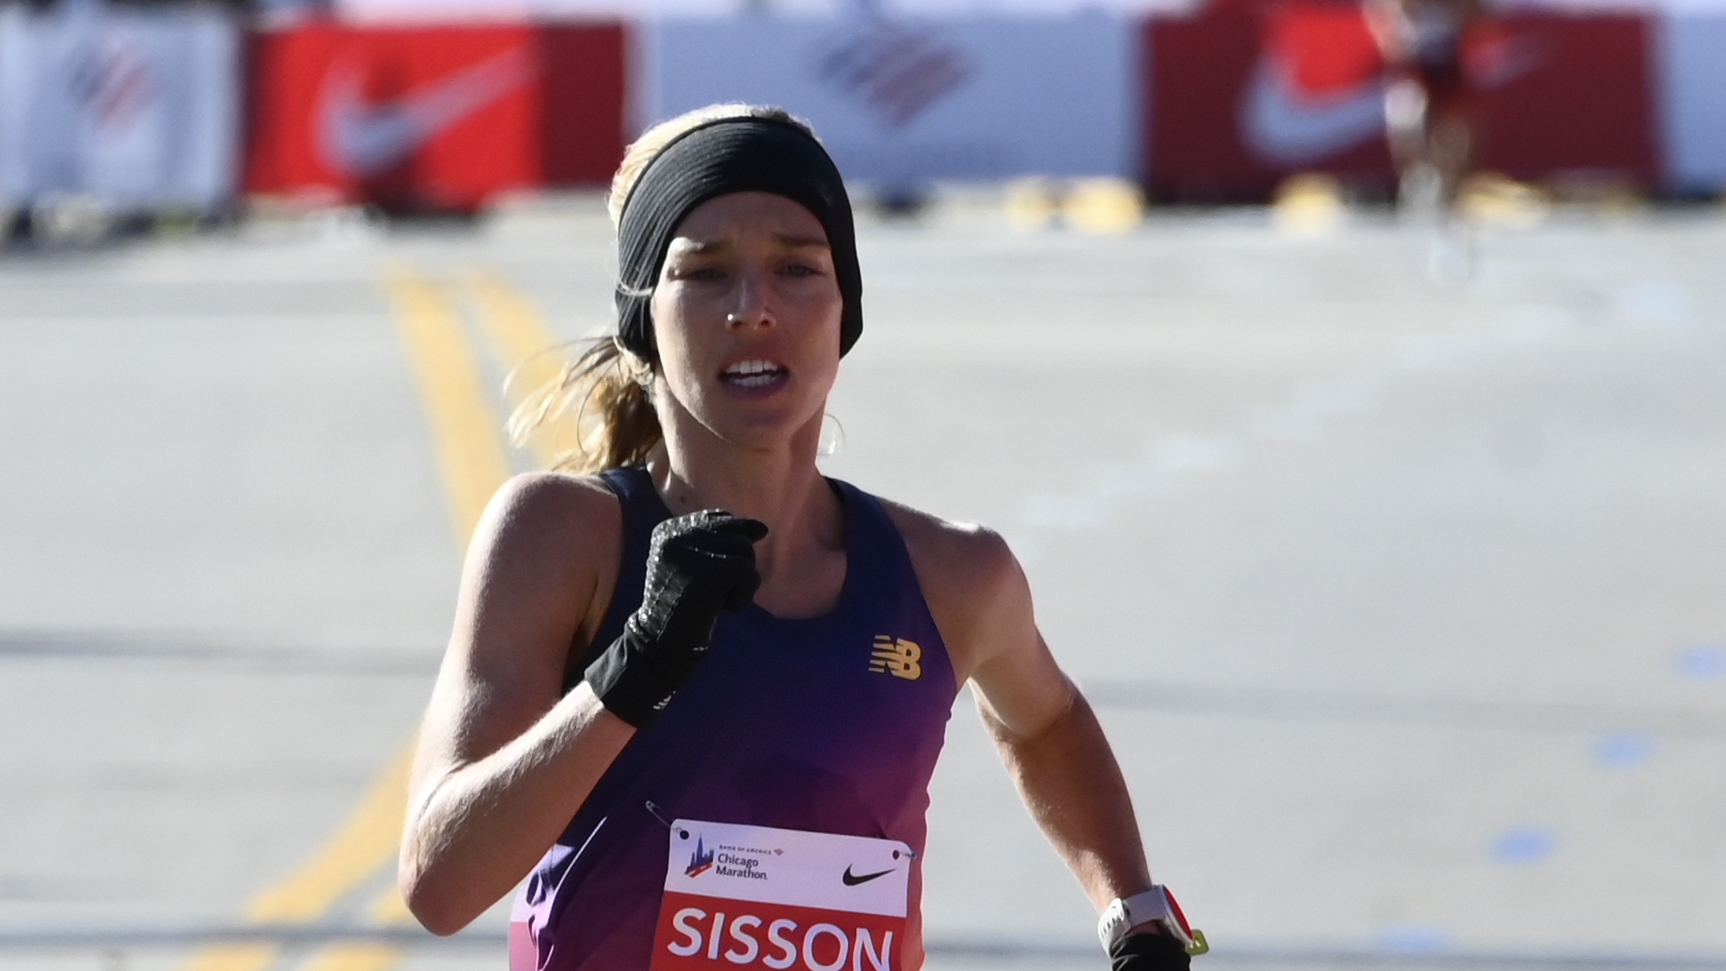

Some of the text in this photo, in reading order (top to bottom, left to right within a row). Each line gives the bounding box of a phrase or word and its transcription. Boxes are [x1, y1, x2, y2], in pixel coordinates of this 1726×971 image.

[868, 634, 921, 681] NB
[717, 853, 759, 869] Chicago
[667, 907, 893, 971] SISSON
